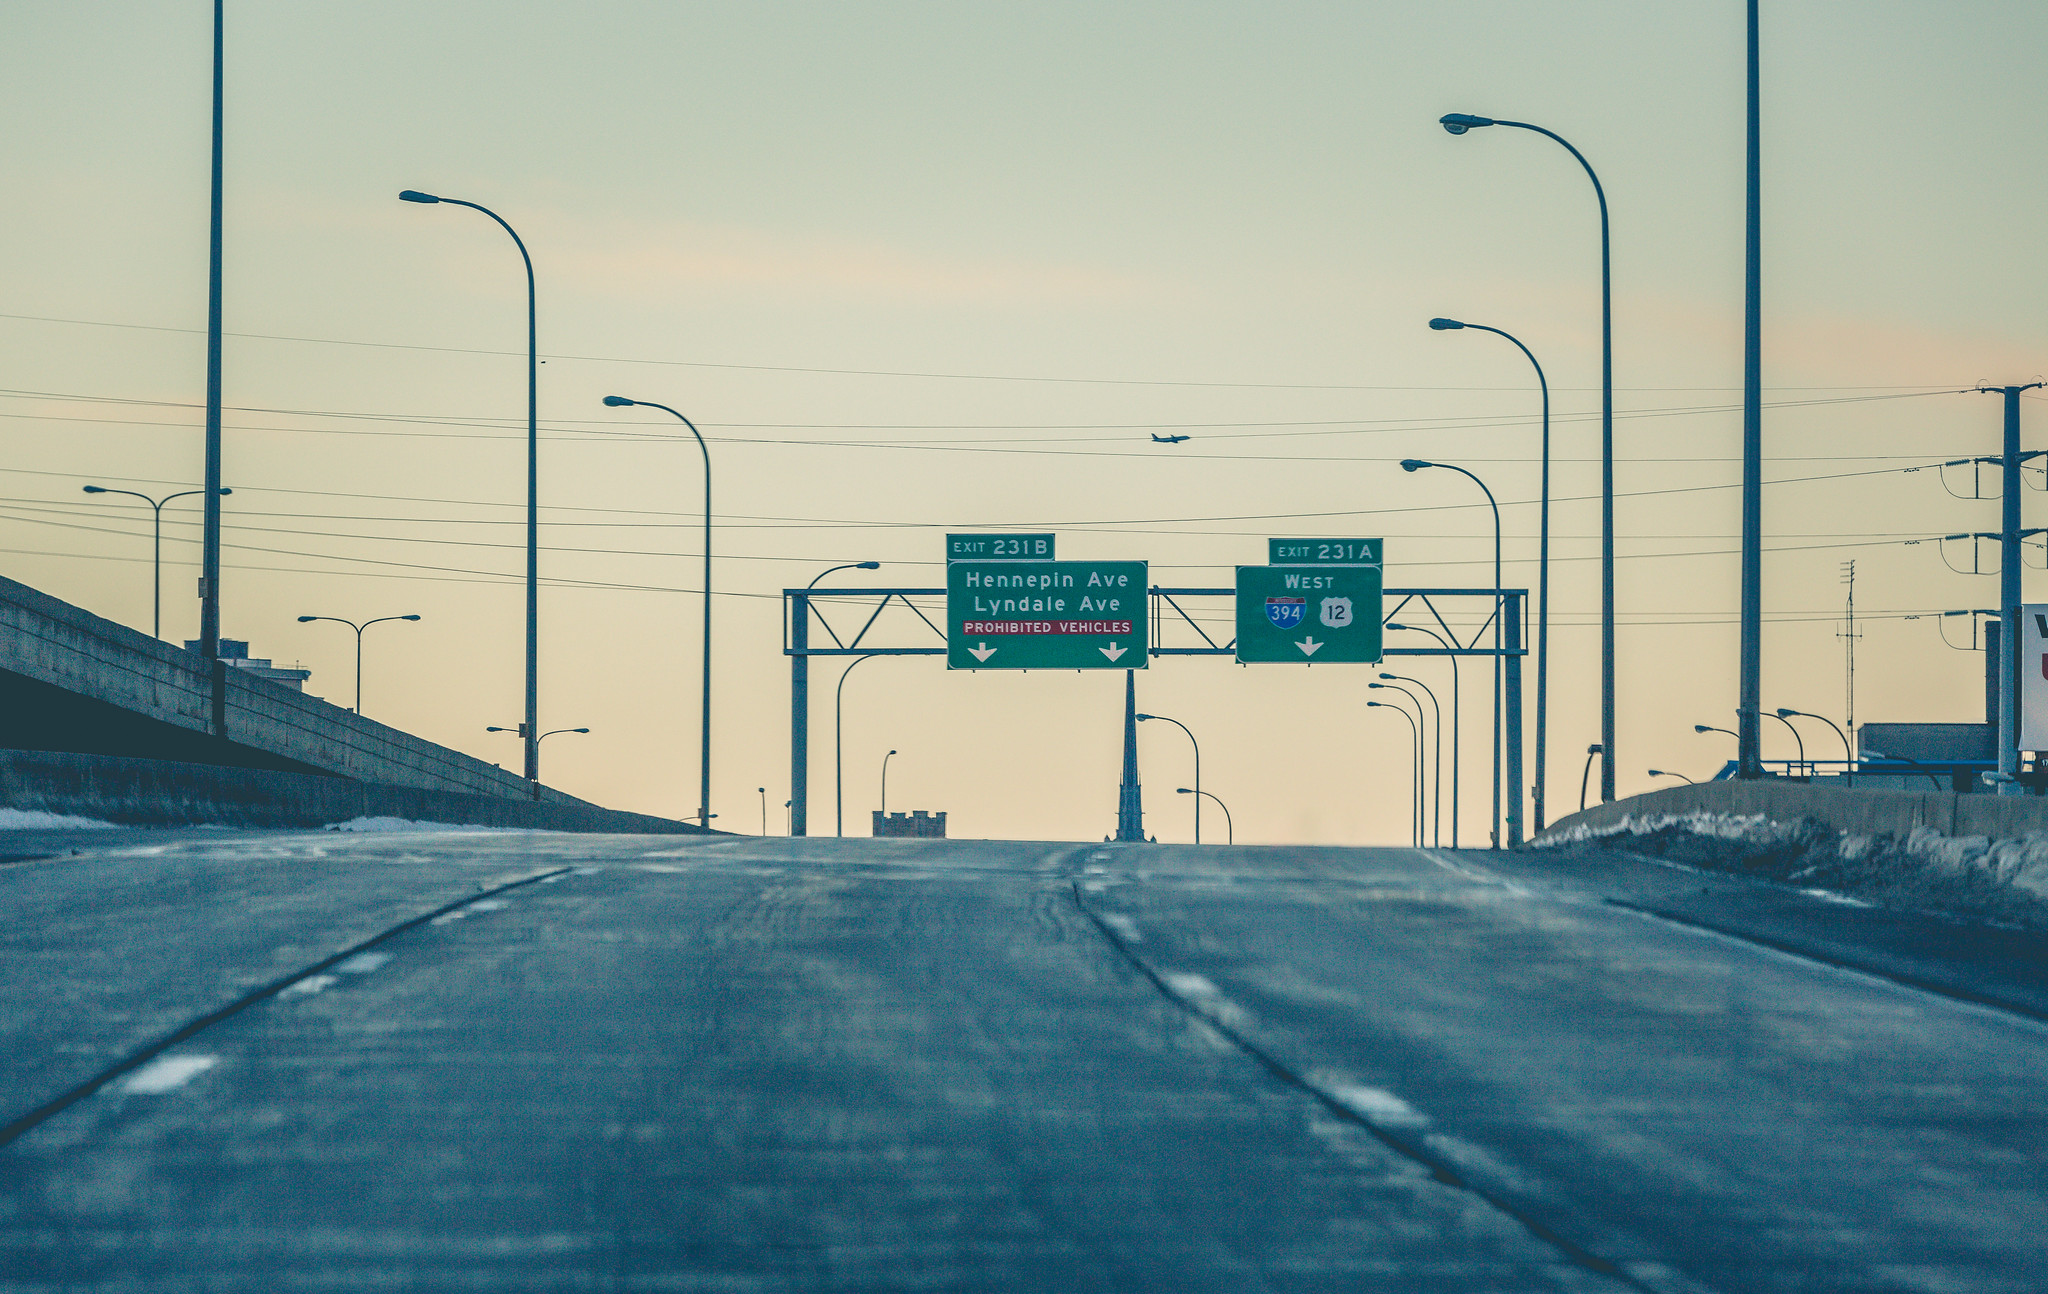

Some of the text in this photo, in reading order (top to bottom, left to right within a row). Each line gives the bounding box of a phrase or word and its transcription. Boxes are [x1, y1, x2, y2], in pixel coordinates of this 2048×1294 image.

[953, 542, 986, 553] EXIT
[1278, 547, 1310, 557] EXIT
[966, 571, 1129, 590] Hennepin Ave
[1285, 574, 1334, 589] WEST
[975, 596, 1121, 616] Lyndale Ave
[1271, 605, 1301, 621] 394
[1328, 605, 1345, 620] 12
[964, 622, 1131, 633] PROHIBITED VEHICLES
